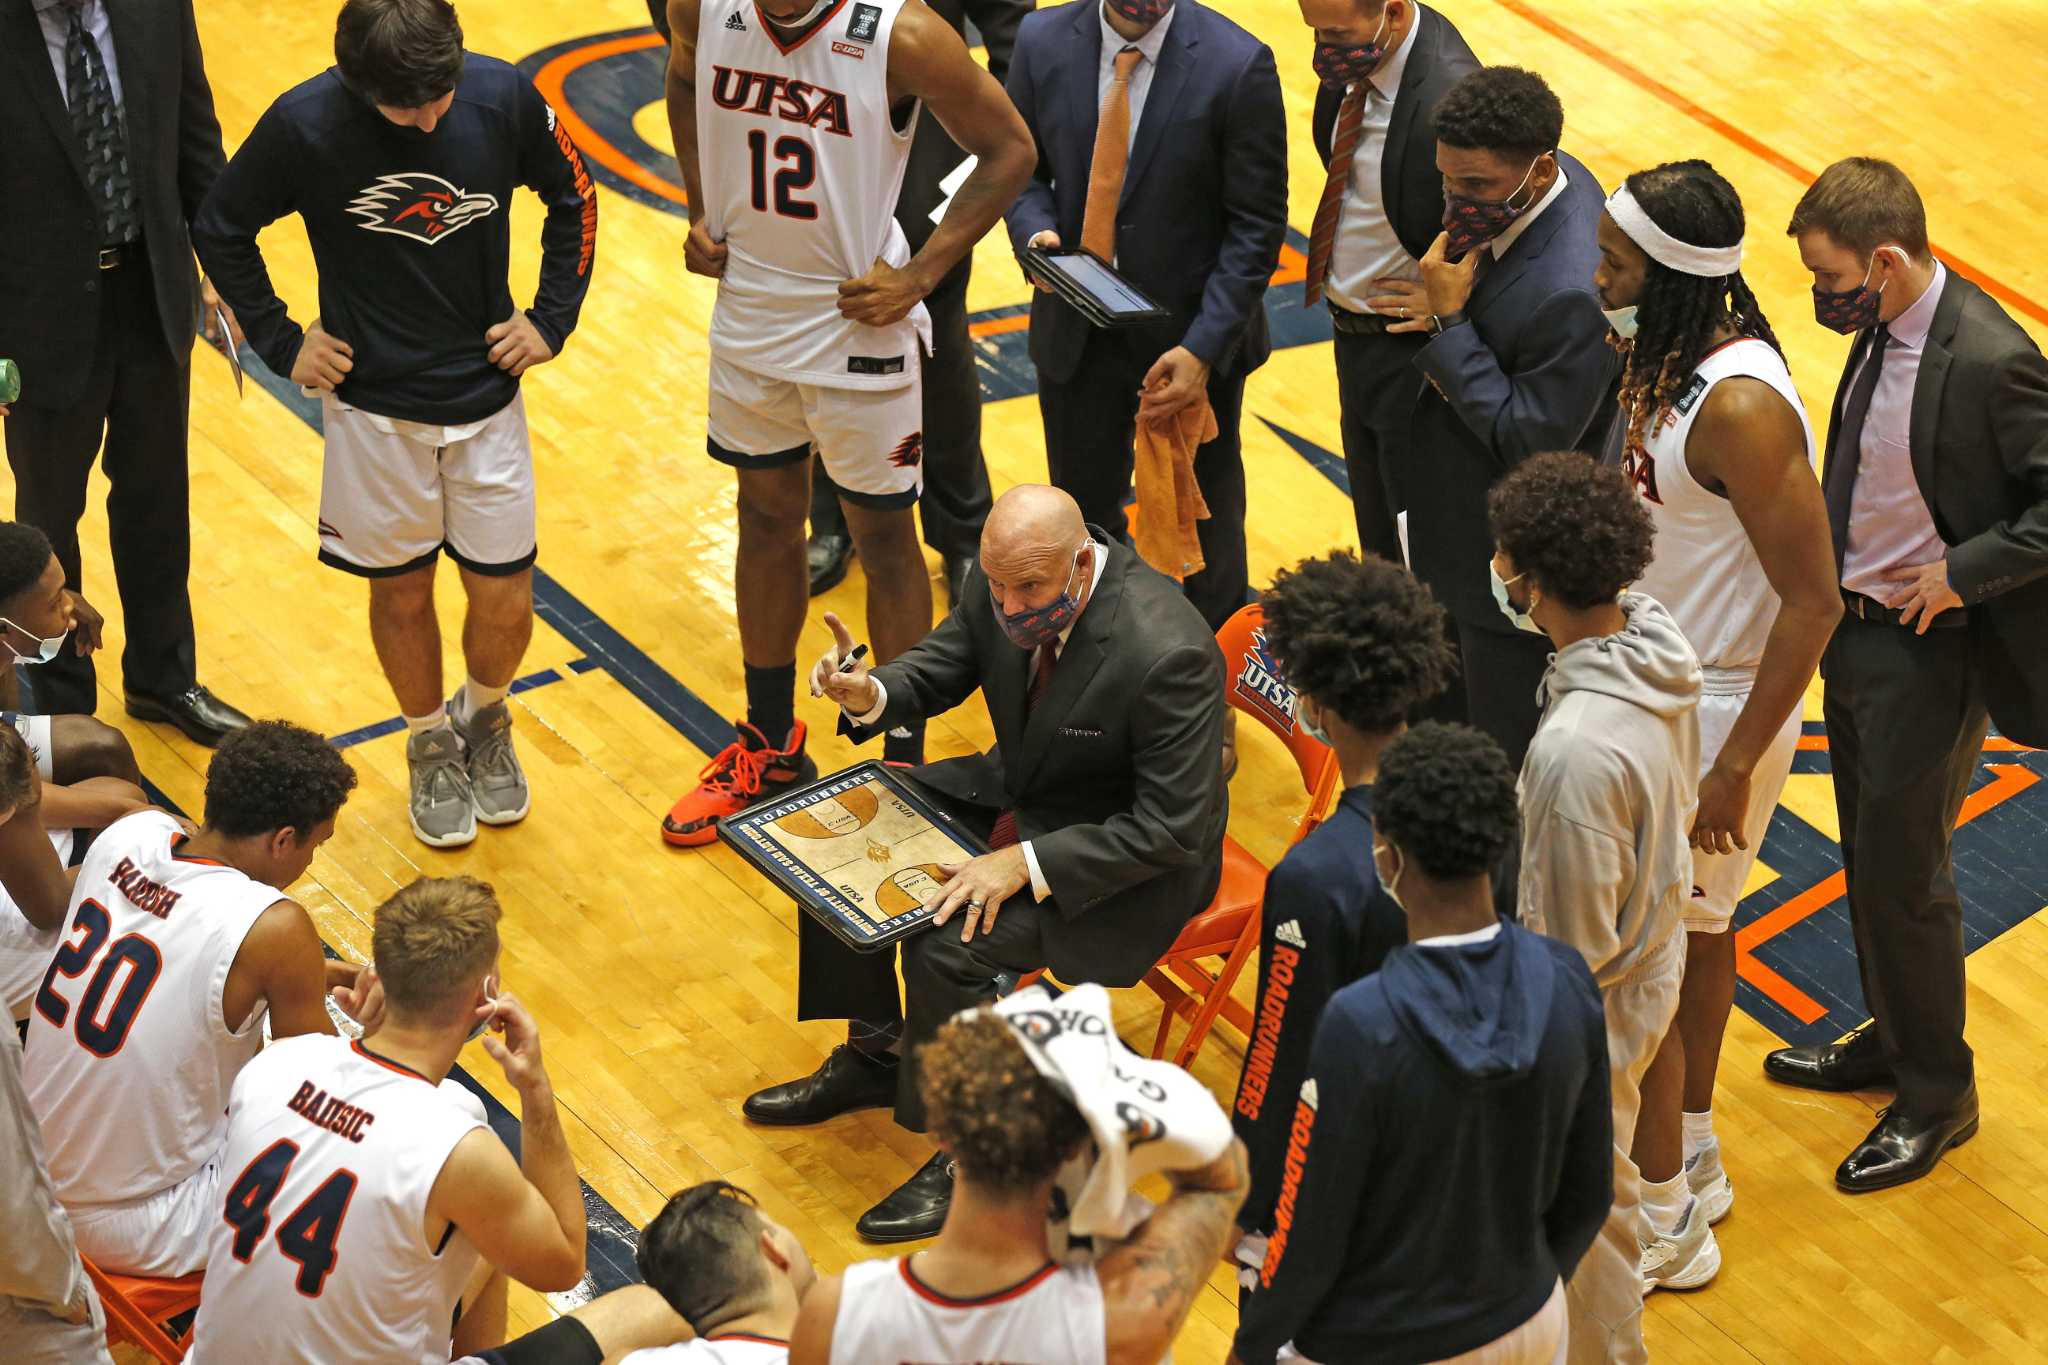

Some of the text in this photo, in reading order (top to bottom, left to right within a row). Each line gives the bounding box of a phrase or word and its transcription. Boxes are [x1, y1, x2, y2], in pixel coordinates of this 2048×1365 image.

[712, 65, 852, 138] UTSA
[748, 129, 818, 220] 12
[1244, 662, 1297, 718] UTSA
[752, 771, 876, 826] ROADRUNNERS
[35, 897, 162, 1058] 20
[1236, 944, 1300, 1121] ROADRUNNERS
[224, 1137, 358, 1298] 44
